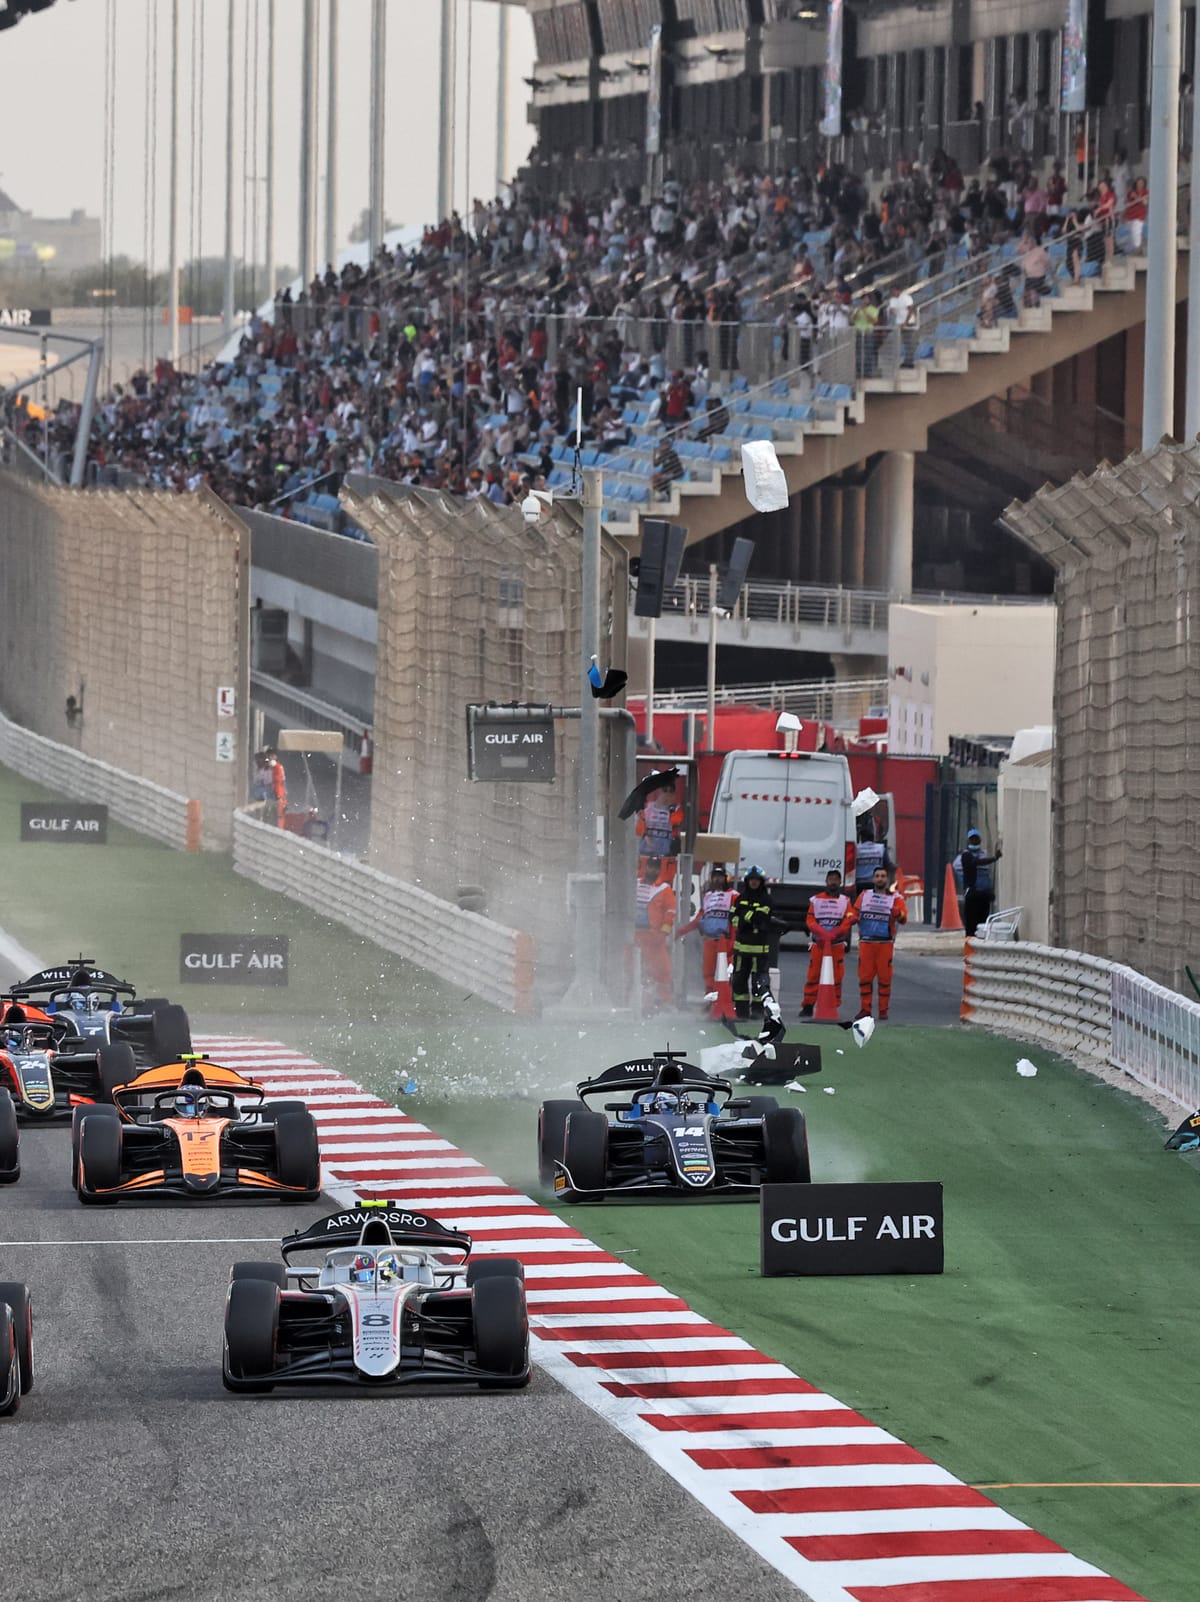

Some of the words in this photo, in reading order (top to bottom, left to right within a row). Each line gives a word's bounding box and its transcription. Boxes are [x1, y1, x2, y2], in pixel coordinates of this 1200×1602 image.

[485, 734, 519, 744] GULF
[521, 733, 544, 744] AIR
[29, 817, 71, 831] GULF
[73, 819, 99, 832] AIR
[813, 858, 842, 869] HP02
[185, 953, 243, 970] GULF
[247, 953, 284, 970] AIR
[42, 971, 104, 979] WILLMS
[20, 1060, 46, 1070] 24
[625, 1064, 684, 1073] WILLS
[673, 1126, 705, 1137] 14
[327, 1211, 427, 1230] ARWDSRO
[770, 1216, 867, 1243] GULF
[875, 1214, 936, 1241] AIR
[362, 1313, 391, 1327] 8
